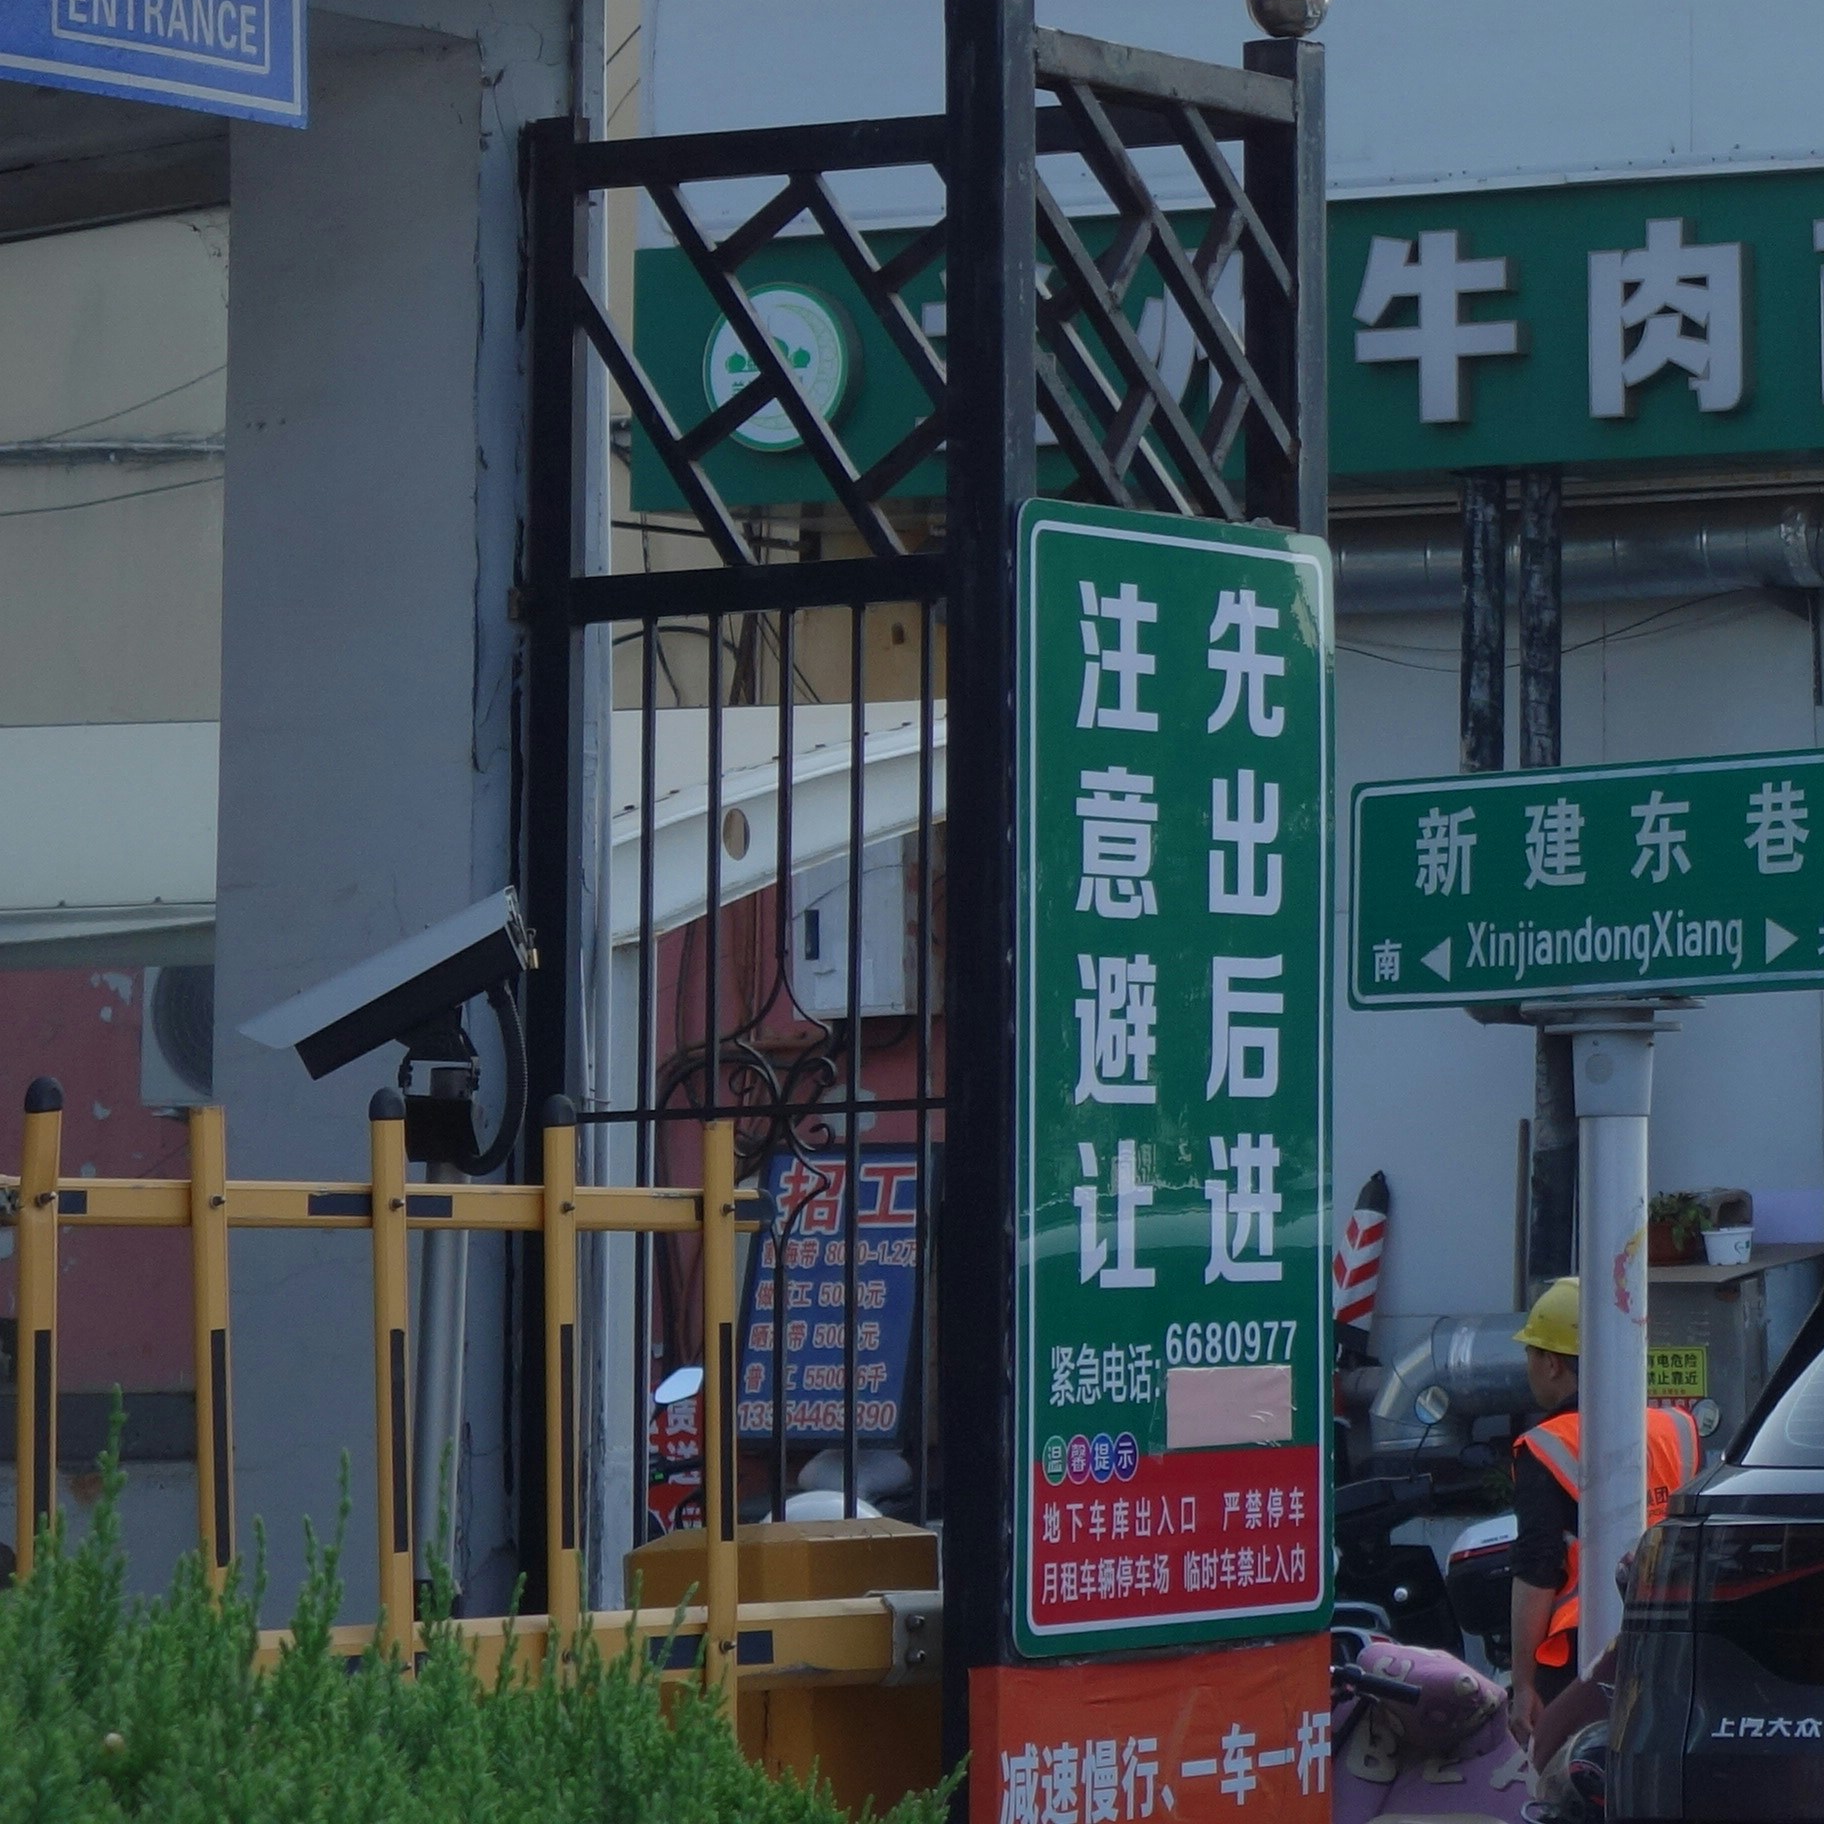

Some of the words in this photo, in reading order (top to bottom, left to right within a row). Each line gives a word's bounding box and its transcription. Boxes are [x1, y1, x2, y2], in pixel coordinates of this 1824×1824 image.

[1414, 780, 1810, 897] 新建东巷
[1074, 580, 1158, 1289] 注意避让
[1205, 587, 1286, 1285] 先出后进
[1372, 939, 1402, 983] 南
[1466, 909, 1743, 981] XinjiandongXiang
[775, 1158, 918, 1236] 招工
[748, 1320, 808, 1351] 晒带
[1049, 1342, 1163, 1408] 紧急电话:
[1165, 1320, 1298, 1365] 6680977
[1045, 1438, 1137, 1480] 温馨提示
[1042, 1495, 1198, 1544] 地下车库出入口
[1222, 1485, 1307, 1532] 严禁停车
[1041, 1553, 1171, 1607] 月租车辆停车场
[1182, 1541, 1307, 1594] 临时车禁止入内
[1711, 1716, 1823, 1740] 上汽大众
